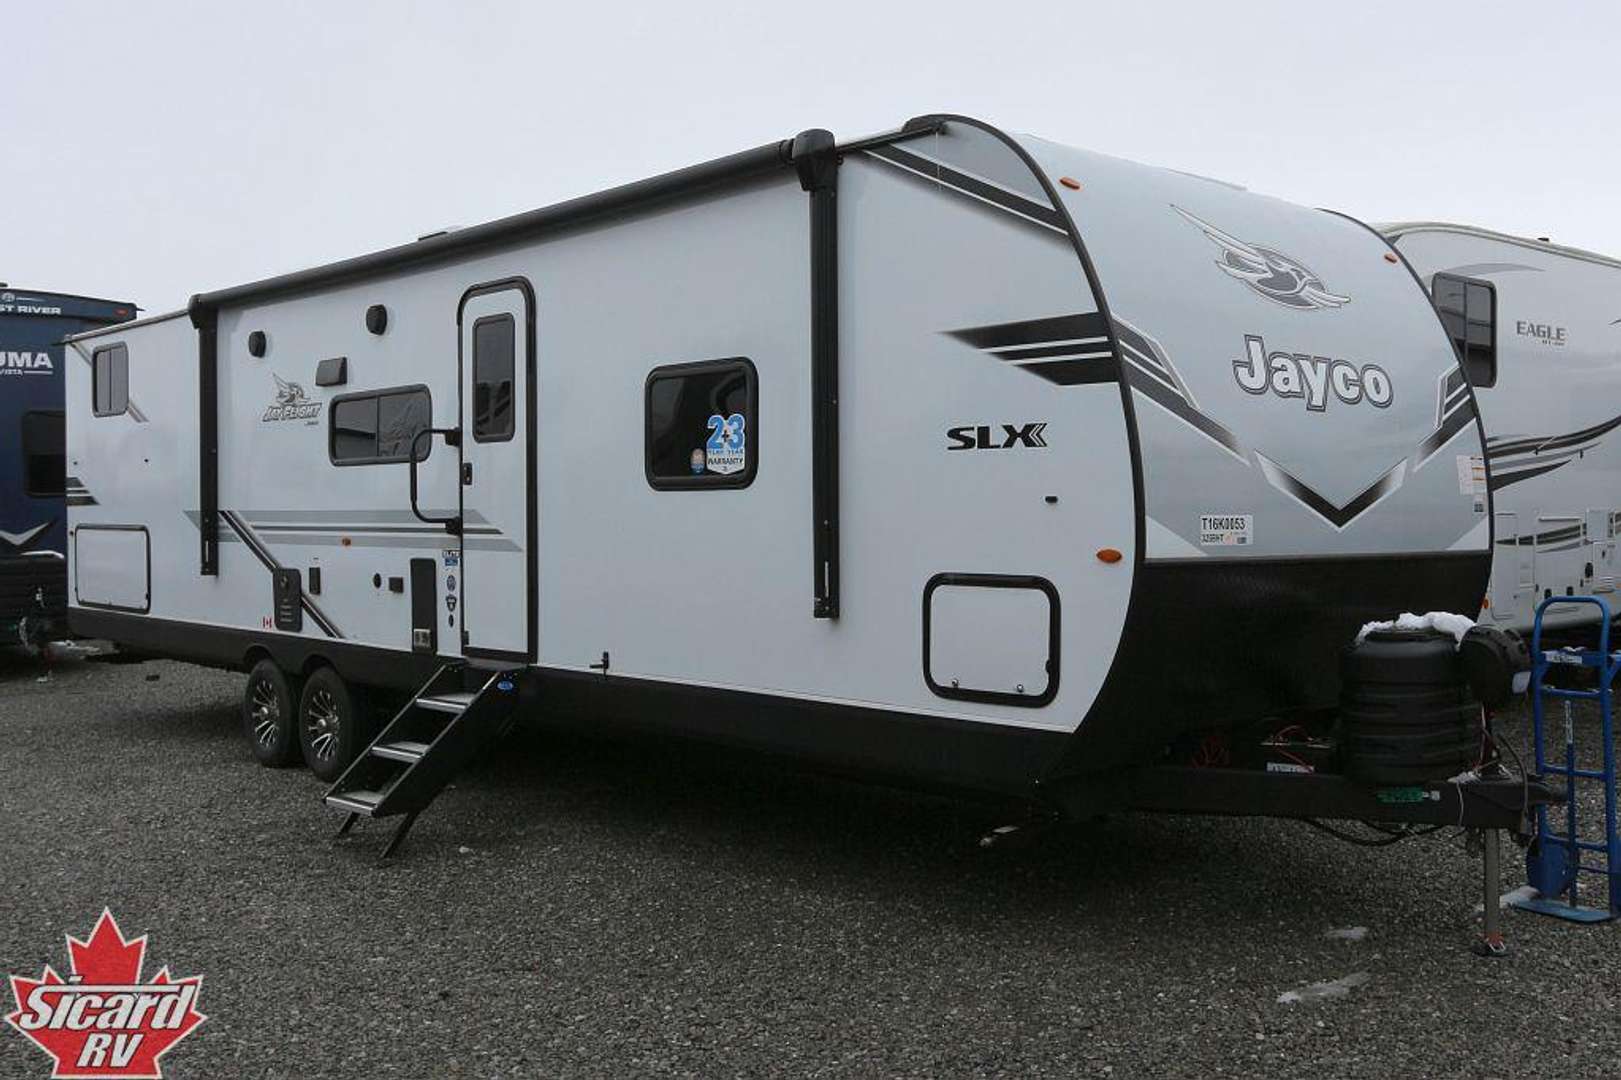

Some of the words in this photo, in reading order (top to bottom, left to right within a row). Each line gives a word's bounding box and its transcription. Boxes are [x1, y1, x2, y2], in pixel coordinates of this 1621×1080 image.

[18, 305, 61, 315] RIVER
[1516, 321, 1566, 341] EAGLE
[1232, 334, 1394, 413] Jayco
[947, 423, 1047, 450] SLX
